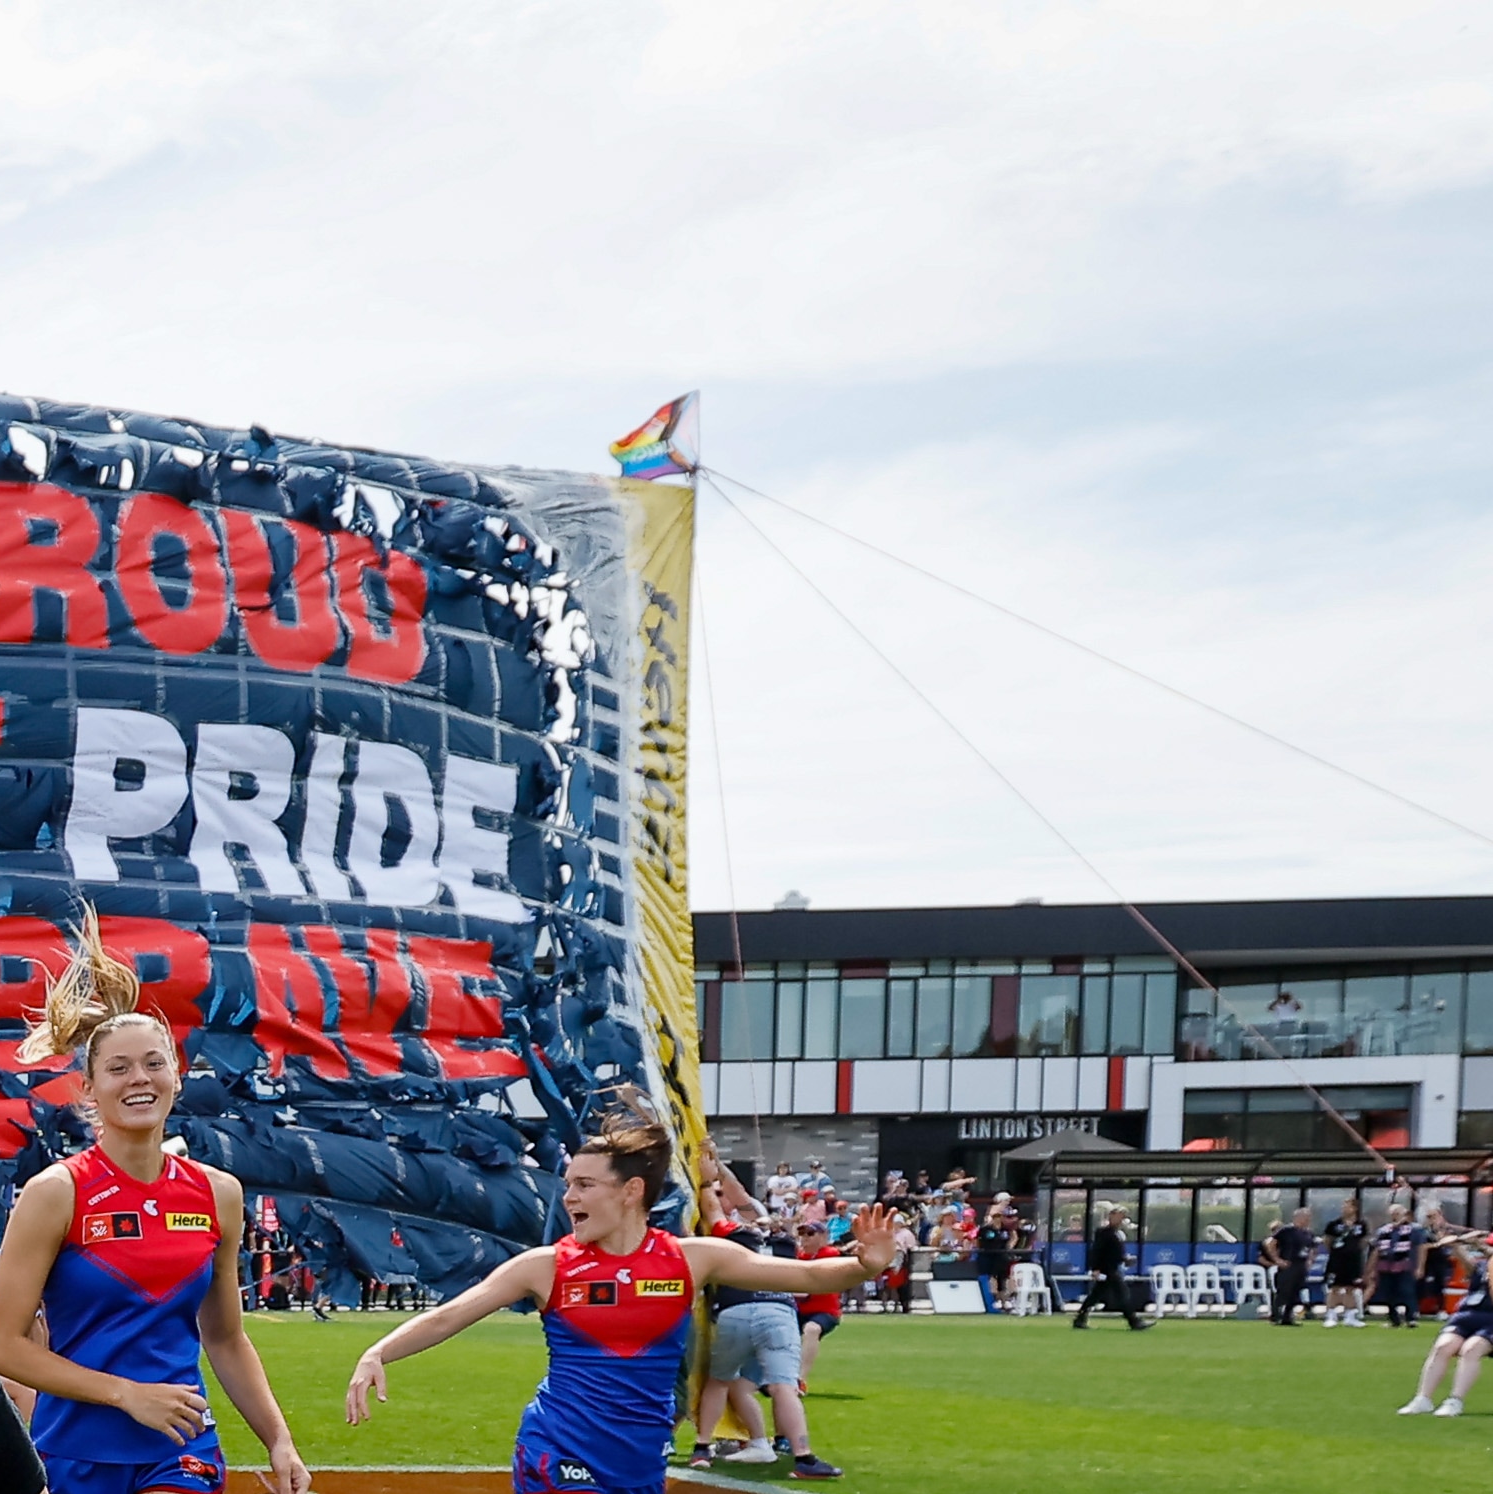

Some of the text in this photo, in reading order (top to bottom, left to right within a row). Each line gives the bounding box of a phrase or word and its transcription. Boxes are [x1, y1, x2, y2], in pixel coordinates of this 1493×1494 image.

[63, 705, 535, 926] PRIDE
[959, 1118, 1028, 1140] LINTON
[172, 1214, 207, 1227] Hertz
[642, 1280, 681, 1293] Hertz
